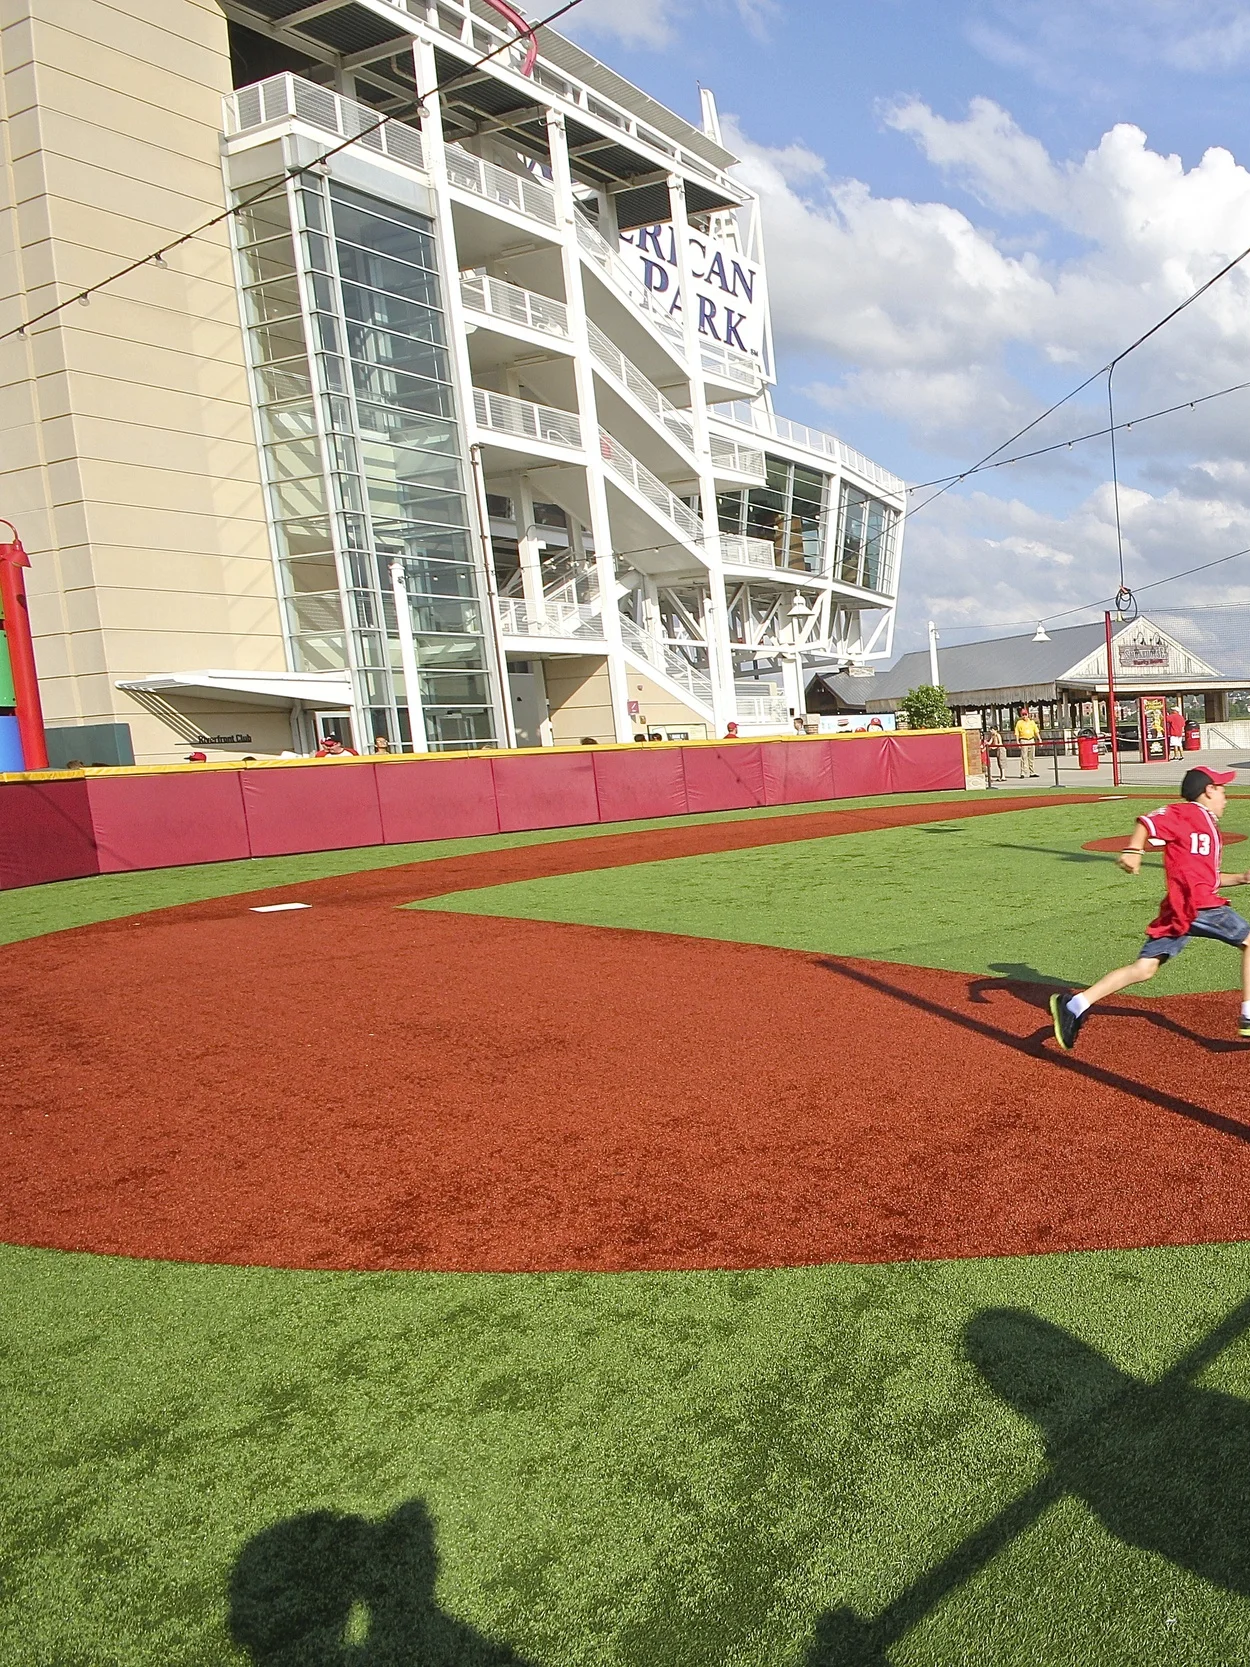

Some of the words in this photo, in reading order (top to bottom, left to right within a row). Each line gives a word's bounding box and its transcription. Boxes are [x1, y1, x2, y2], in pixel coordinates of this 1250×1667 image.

[619, 224, 756, 304] RICAN
[198, 735, 235, 745] Riverfront
[236, 733, 252, 743] Club
[1190, 832, 1211, 856] 13
